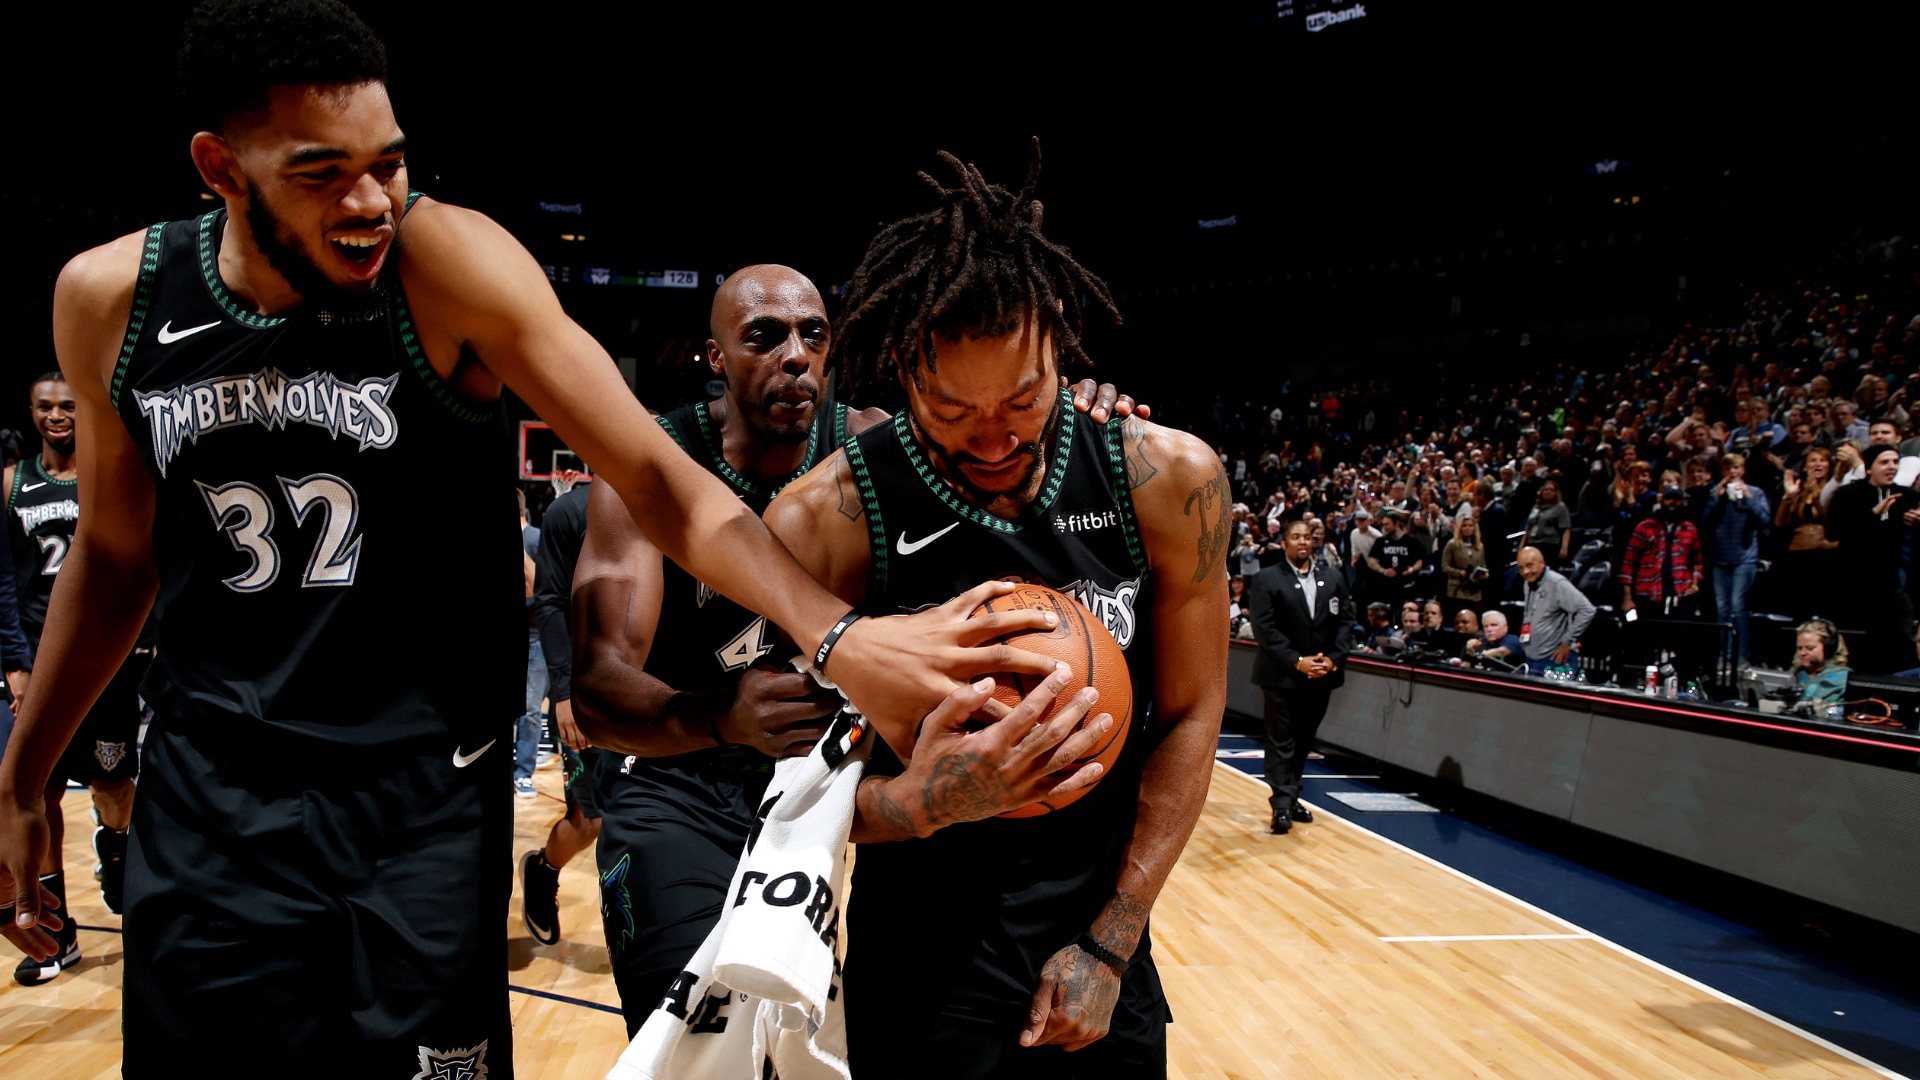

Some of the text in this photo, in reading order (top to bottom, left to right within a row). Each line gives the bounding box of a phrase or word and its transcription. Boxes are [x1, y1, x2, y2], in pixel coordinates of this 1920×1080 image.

[670, 273, 693, 284] 128
[132, 365, 402, 480] TIMBERWOLVES
[14, 499, 79, 538] TIMBERWO
[193, 472, 363, 593] 32
[1068, 510, 1117, 533] fitbit
[36, 534, 75, 576] 2
[714, 614, 775, 673] 4
[816, 621, 847, 663] WE FLIP
